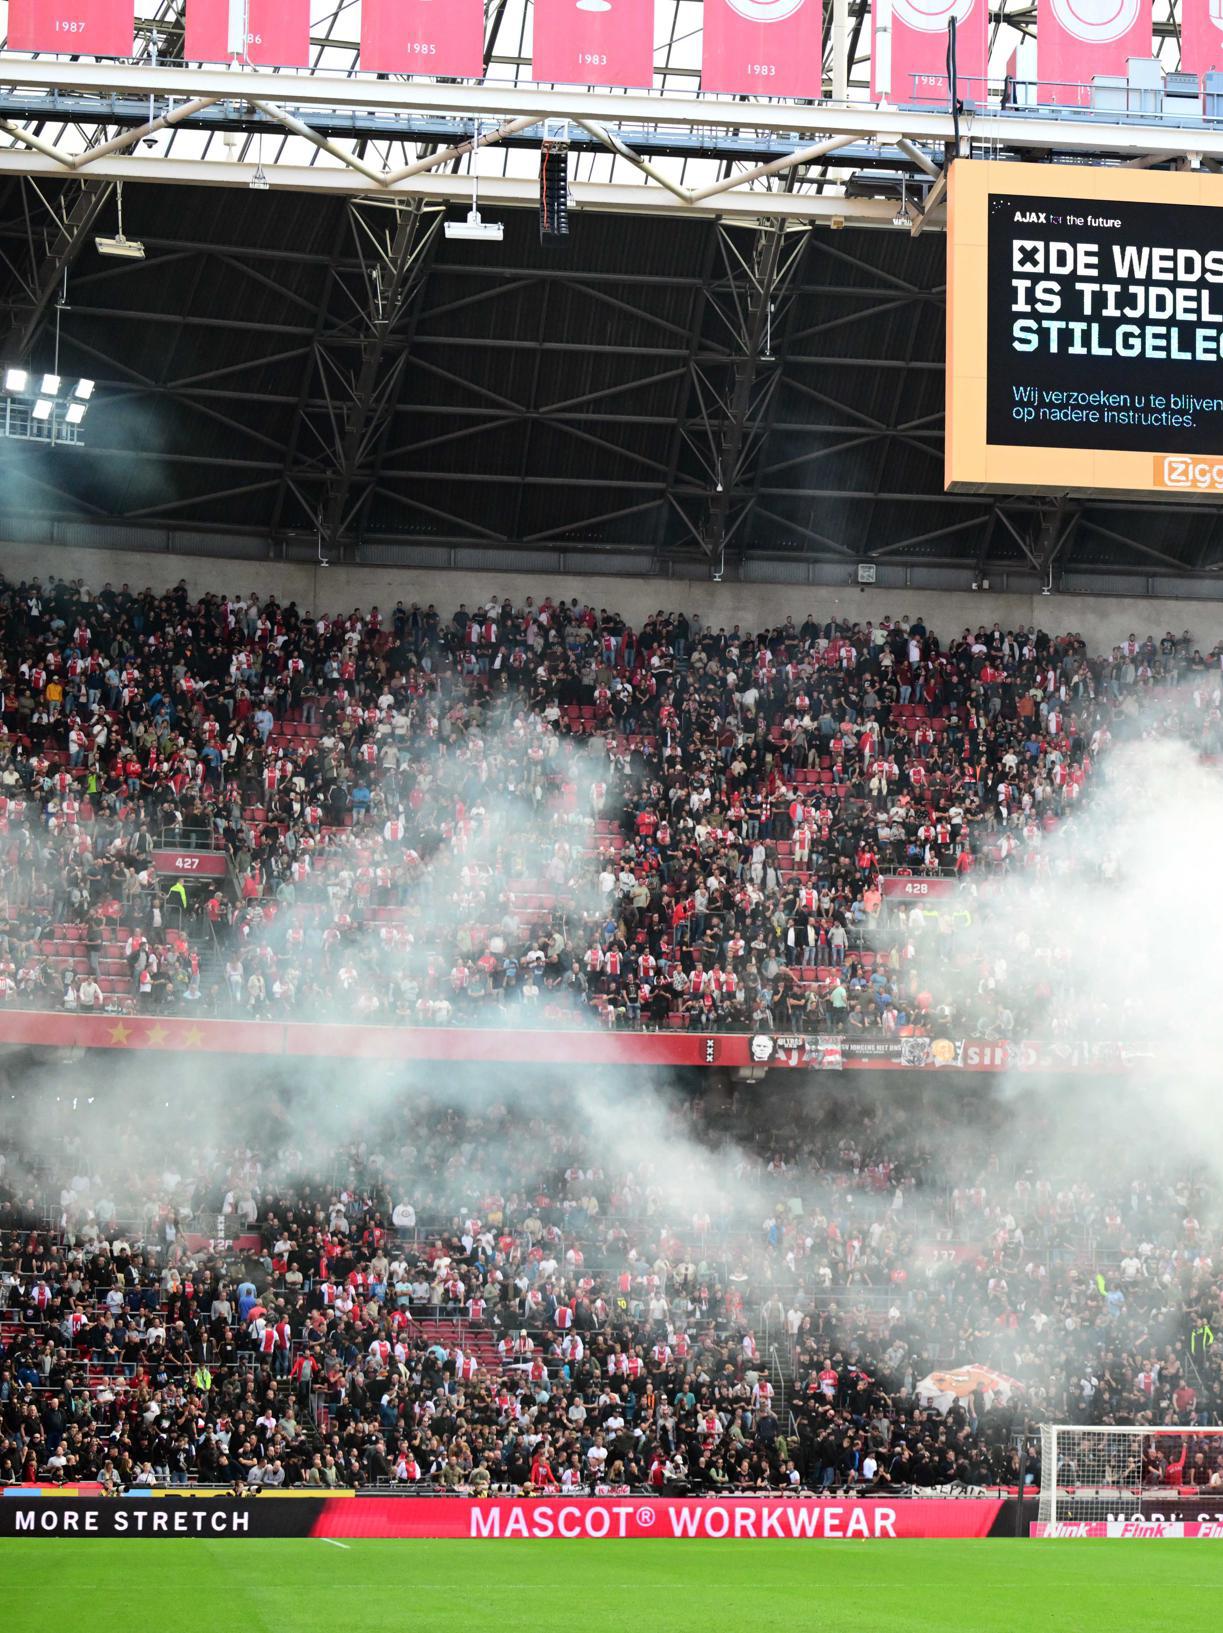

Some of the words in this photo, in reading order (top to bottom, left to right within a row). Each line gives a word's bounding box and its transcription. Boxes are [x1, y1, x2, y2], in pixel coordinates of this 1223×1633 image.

[55, 21, 86, 33] 1987
[406, 42, 437, 55] 1985
[578, 53, 608, 66] 1983
[747, 64, 776, 77] 1983
[915, 76, 943, 87] 1982
[1014, 211, 1046, 223] AJAX
[1066, 215, 1084, 225] the
[1087, 215, 1122, 227] future
[1049, 242, 1099, 277] DE
[1011, 279, 1061, 313] IS
[1013, 386, 1038, 405] Wij
[1043, 391, 1130, 407] verzoeken
[1135, 396, 1145, 408] u
[1149, 394, 1166, 409] te
[1170, 393, 1223, 413] blijven
[1012, 409, 1035, 422] op
[1039, 406, 1099, 423] nadere
[1104, 408, 1197, 428] instructies.
[176, 857, 200, 869] 427
[905, 883, 928, 894] 428
[15, 1511, 99, 1531] MORE
[114, 1511, 250, 1531] STRETCH
[470, 1506, 656, 1537] MASCOT®
[669, 1506, 897, 1537] WORKWEAR
[1121, 1523, 1167, 1537] Flink
